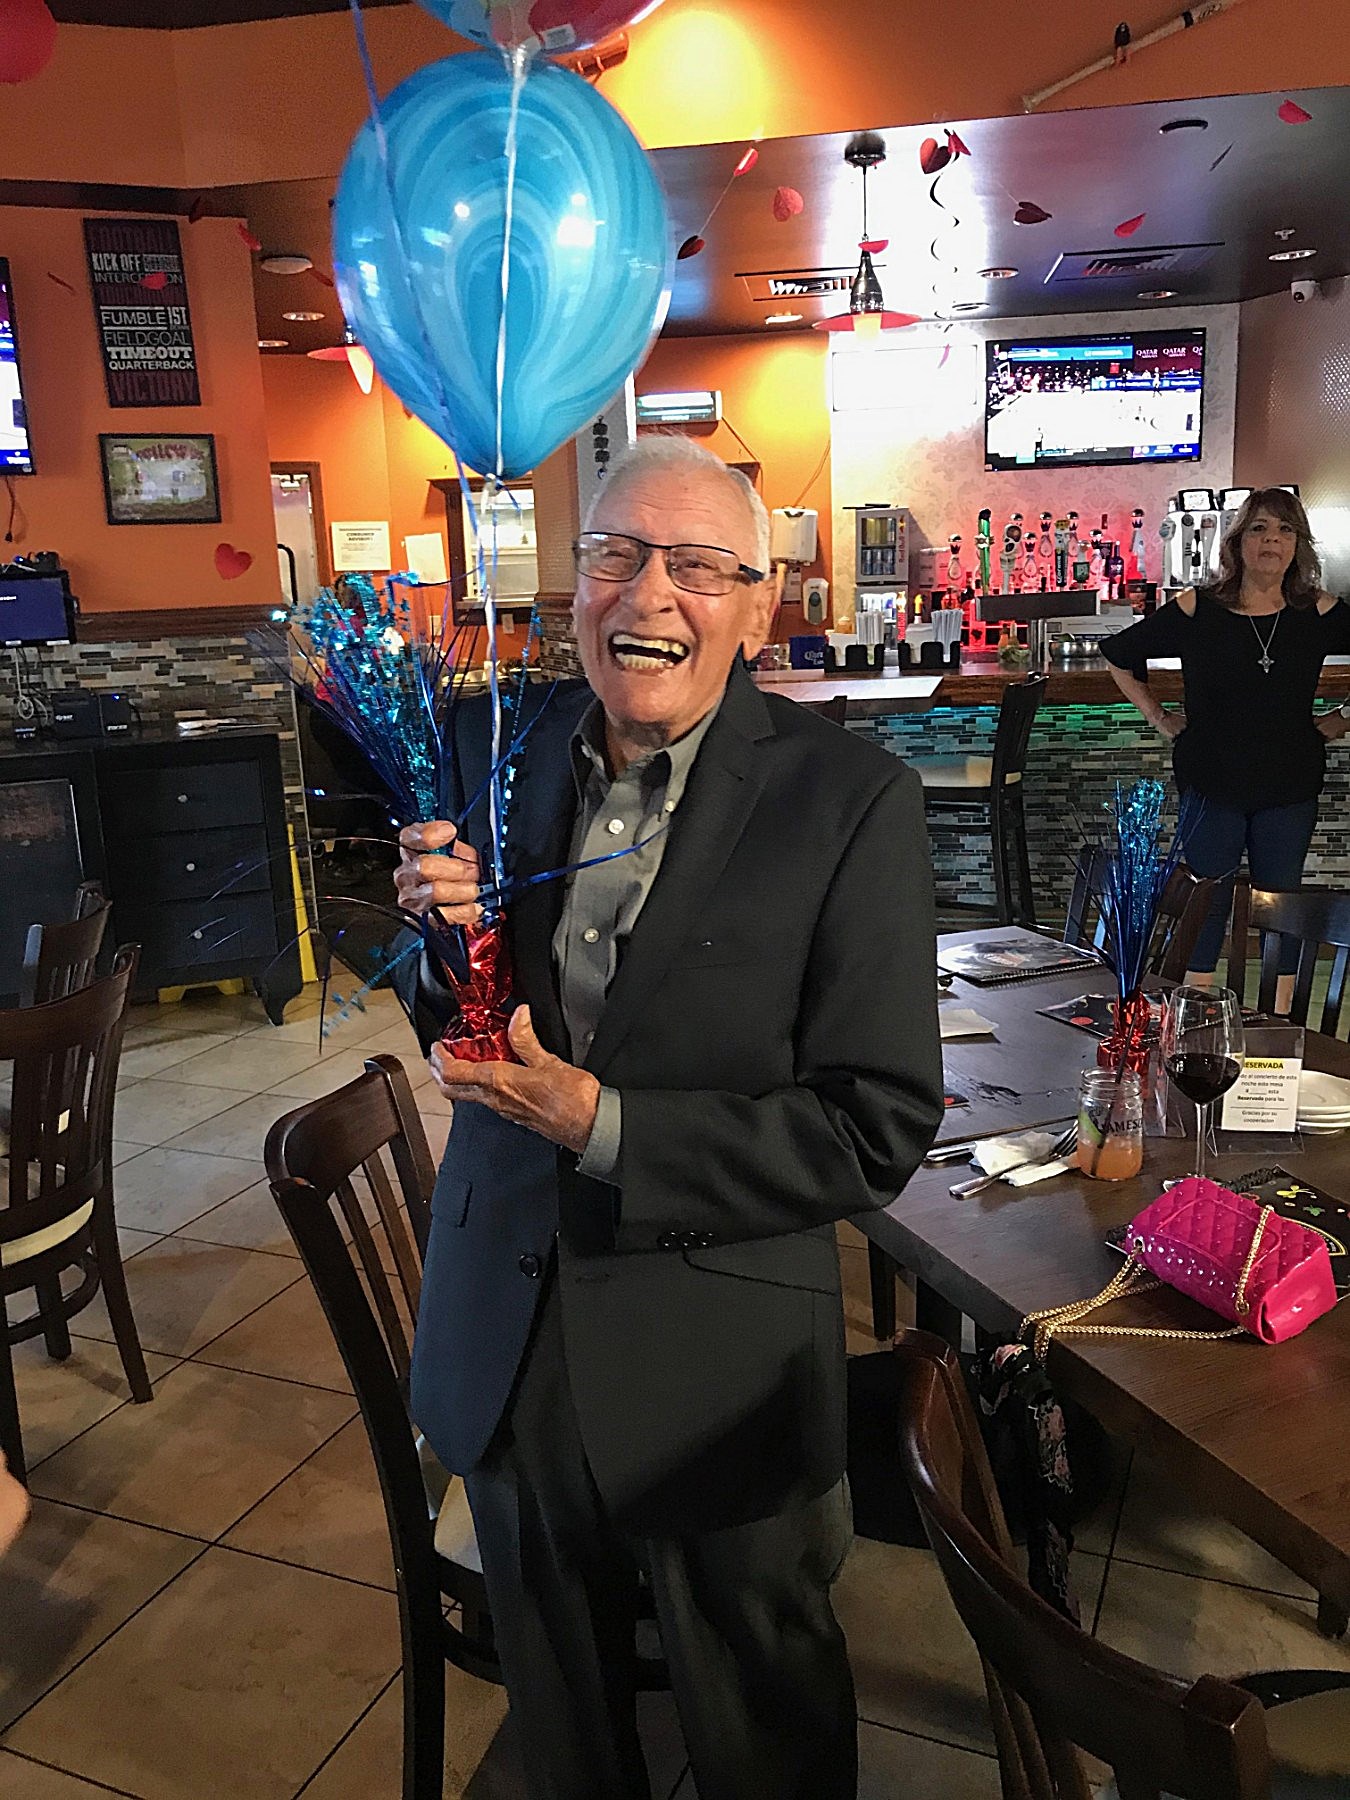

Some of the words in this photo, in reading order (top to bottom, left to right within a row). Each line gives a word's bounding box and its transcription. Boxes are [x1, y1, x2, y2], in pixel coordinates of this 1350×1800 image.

[91, 252, 119, 271] KICK
[119, 253, 141, 271] OFF
[101, 311, 167, 325] FUMBLE
[106, 346, 193, 360] TIMEOUT
[1136, 348, 1158, 356] QATAR
[1162, 347, 1187, 355] QATAR
[108, 360, 195, 371] QUARTERBACK
